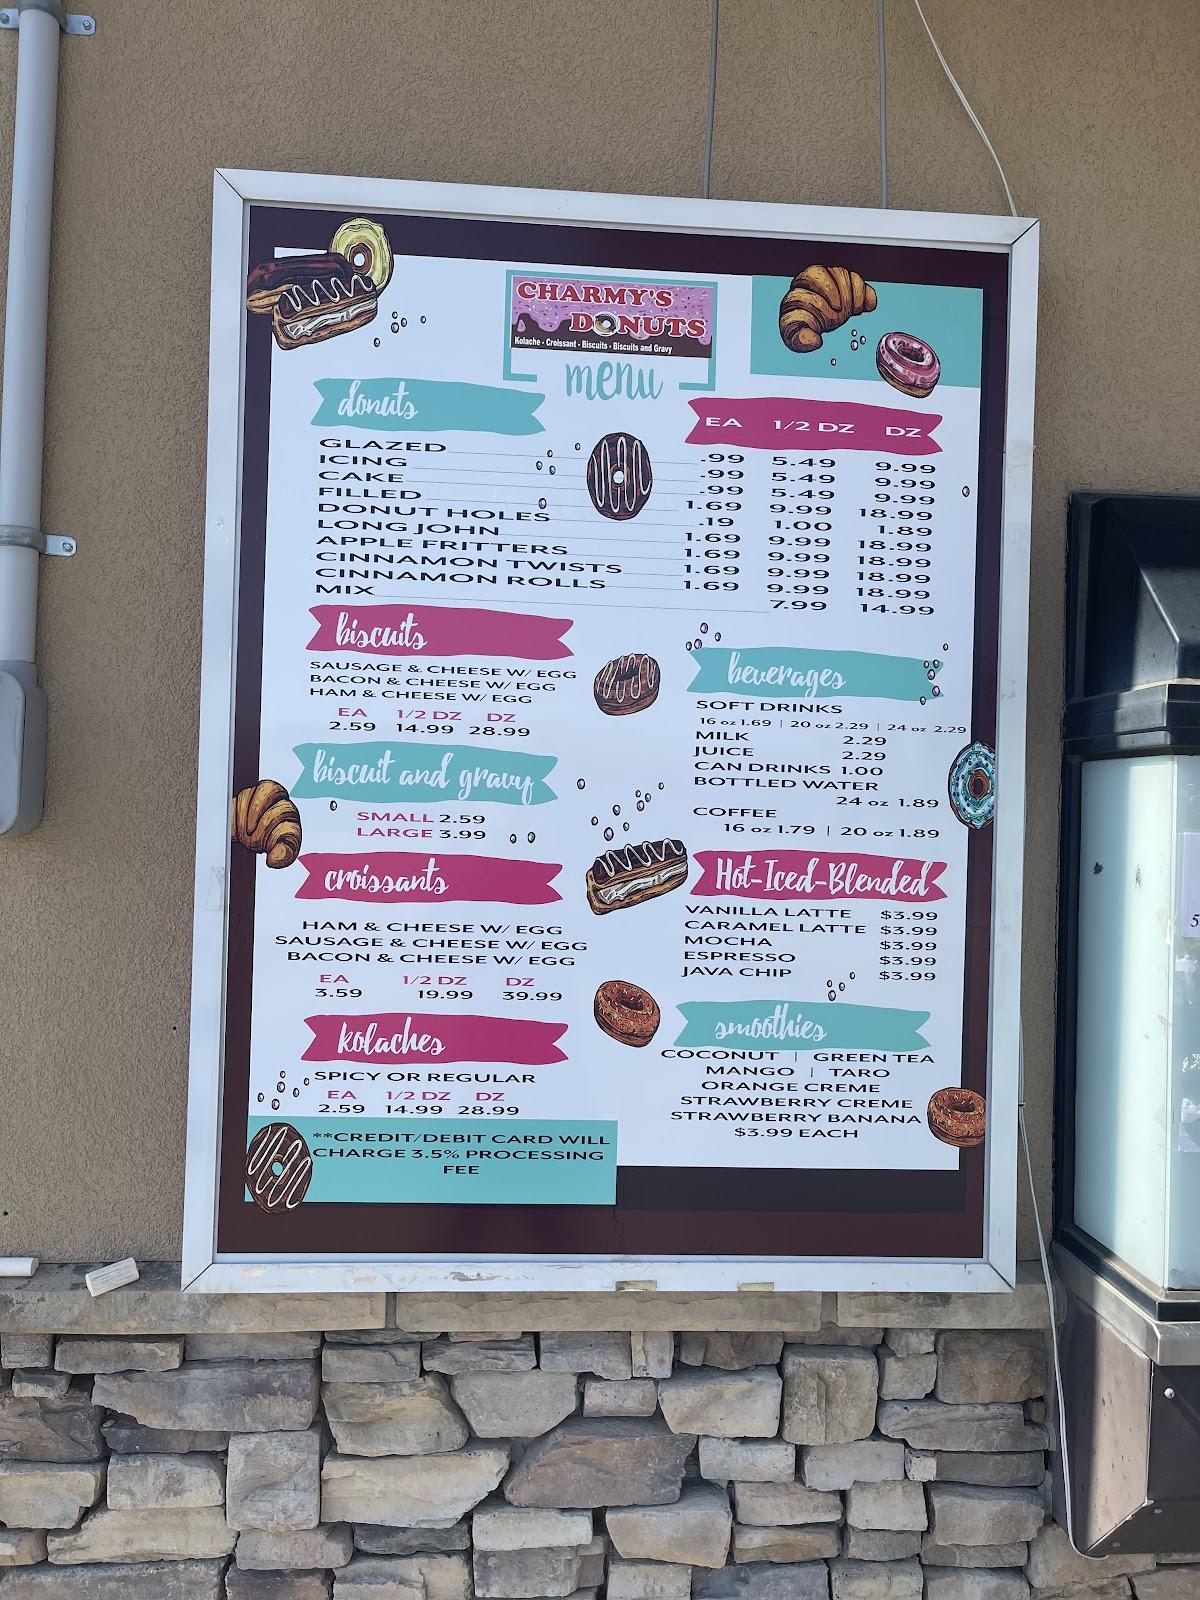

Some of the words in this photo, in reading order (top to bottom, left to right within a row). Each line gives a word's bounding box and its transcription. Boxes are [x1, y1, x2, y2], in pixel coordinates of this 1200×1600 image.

[517, 282, 673, 307] CHARMY'S
[515, 336, 541, 346] Kolache
[546, 338, 576, 348] Croissant
[582, 340, 608, 350] Biscuits
[613, 342, 639, 352] Biscuits
[640, 344, 652, 352] and
[654, 344, 672, 355] Gravy
[566, 361, 663, 401] menu
[338, 379, 418, 420] donuts
[706, 417, 742, 428] EA
[774, 420, 810, 431] 1/2
[819, 422, 854, 434] DZ
[886, 426, 921, 438] DZ
[320, 438, 446, 452] GLAZED
[320, 454, 407, 467] ICING
[701, 453, 744, 464] .99
[772, 456, 836, 468] 5.49
[875, 461, 936, 474] 9.99
[319, 471, 403, 483] CAKE
[319, 487, 421, 500] FILLED
[318, 503, 438, 517] DONUT
[447, 508, 550, 522] HOLES
[318, 519, 407, 532] LONG
[413, 523, 499, 536] JOHN
[699, 517, 734, 527] .19
[775, 520, 832, 532] 1.00
[879, 525, 932, 537] 1.89
[316, 536, 413, 548] APPLE
[423, 540, 568, 555] FRITTERS
[316, 552, 497, 568] CINNAMON
[506, 559, 622, 574] TWISTS
[315, 568, 497, 584] CINNAMON
[507, 576, 606, 589] ROLLS
[316, 584, 374, 595] MIX
[770, 599, 827, 611] 7.99
[860, 603, 934, 616] 14.99
[336, 611, 428, 650] biscuits
[310, 661, 402, 672] SAUSAGE
[407, 664, 422, 673] &
[427, 665, 501, 676] CHEESE
[506, 668, 532, 677] W/
[537, 670, 576, 679] EGG
[727, 651, 846, 698] beverages
[310, 688, 356, 697] HAM
[362, 689, 377, 698] &
[381, 690, 456, 701] CHEESE
[461, 693, 487, 702] W/
[492, 694, 532, 704] EGG
[339, 707, 367, 717] EA
[696, 700, 755, 711] SOFT
[760, 702, 842, 714] DRINKS
[397, 709, 426, 720] 1/2
[433, 711, 461, 721] DZ
[487, 713, 516, 723] DZ
[700, 717, 716, 725] 16
[741, 719, 771, 727] 1.69
[790, 720, 811, 728] 20
[835, 722, 868, 730] 2.29
[329, 721, 376, 732] 2.59
[397, 723, 454, 734] 14.99
[469, 726, 530, 737] 28.99
[887, 723, 906, 731] 24
[934, 725, 966, 734] 2.29
[696, 731, 748, 741] MILK
[843, 735, 886, 746] 2.29
[694, 746, 754, 757] JUICE
[842, 751, 886, 761] 2.29
[695, 761, 741, 771] CAN
[749, 763, 831, 774] DRINKS
[842, 766, 883, 776] 1.00
[313, 748, 395, 785] biscuit
[399, 753, 453, 788] and
[457, 766, 535, 805] gravy
[695, 776, 797, 788] BOTTLED
[802, 780, 878, 791] WATER
[836, 796, 862, 806] 24
[899, 798, 939, 808] 1.89
[357, 811, 434, 823] SMALL
[439, 814, 485, 824] 2.59
[693, 807, 777, 818] COFFEE
[357, 827, 433, 838] LARGE
[440, 829, 486, 840] 3.99
[724, 823, 745, 833] 16
[779, 825, 815, 835] 1.79
[841, 826, 867, 836] 20
[900, 828, 939, 839] 1.89
[325, 857, 449, 894] croissants
[685, 905, 778, 916] VANILLA
[785, 908, 851, 918] LATTE
[881, 910, 938, 921] $3.99
[303, 921, 357, 931] HAM
[364, 922, 380, 932] &
[387, 922, 474, 933] CHEESE
[480, 924, 510, 934] W/
[516, 925, 562, 935] EGG
[685, 920, 794, 932] CARAMEL
[800, 923, 866, 934] LATTE
[685, 935, 772, 947] MOCHA
[684, 951, 796, 963] ESPRESSO
[681, 966, 733, 978] JAVA
[739, 967, 792, 978] CHIP
[320, 974, 349, 984] EA
[403, 975, 431, 985] 1/2
[438, 976, 467, 986] DZ
[506, 977, 534, 987] DZ
[315, 988, 362, 998] 3.59
[419, 990, 473, 1000] 19.99
[503, 991, 562, 1001] 39.99
[715, 1003, 827, 1042] smoothies
[337, 1016, 446, 1055] kolaches
[661, 1049, 779, 1061] COCONUT
[813, 1052, 886, 1063] GREEN
[893, 1054, 934, 1063] TEA
[314, 1071, 381, 1081] SPICY
[387, 1072, 421, 1082] OR
[428, 1073, 535, 1083] REGULAR
[706, 1066, 795, 1076] MANGO
[829, 1068, 890, 1078] TARO
[702, 1081, 798, 1092] ORANGE
[804, 1083, 880, 1093] CREME
[328, 1090, 357, 1100] EA
[386, 1091, 415, 1100] 1/2
[422, 1091, 451, 1101] DZ
[476, 1092, 504, 1102] DZ
[681, 1096, 832, 1107] STRAWBERRY
[837, 1099, 912, 1109] CREME
[319, 1104, 365, 1114] 2.59
[386, 1105, 442, 1115] 14.99
[458, 1105, 519, 1116] 28.99
[671, 1111, 822, 1122] STRAWBERRY
[828, 1114, 921, 1124] BANANA
[734, 1127, 792, 1138] $3.99
[799, 1129, 858, 1138] EACH
[492, 1134, 553, 1144] CARD
[559, 1135, 610, 1145] WILL
[313, 1148, 406, 1158] CHARGE
[412, 1149, 460, 1159] 3.5%
[466, 1150, 603, 1161] PROCESSING
[444, 1165, 479, 1175] FEE
